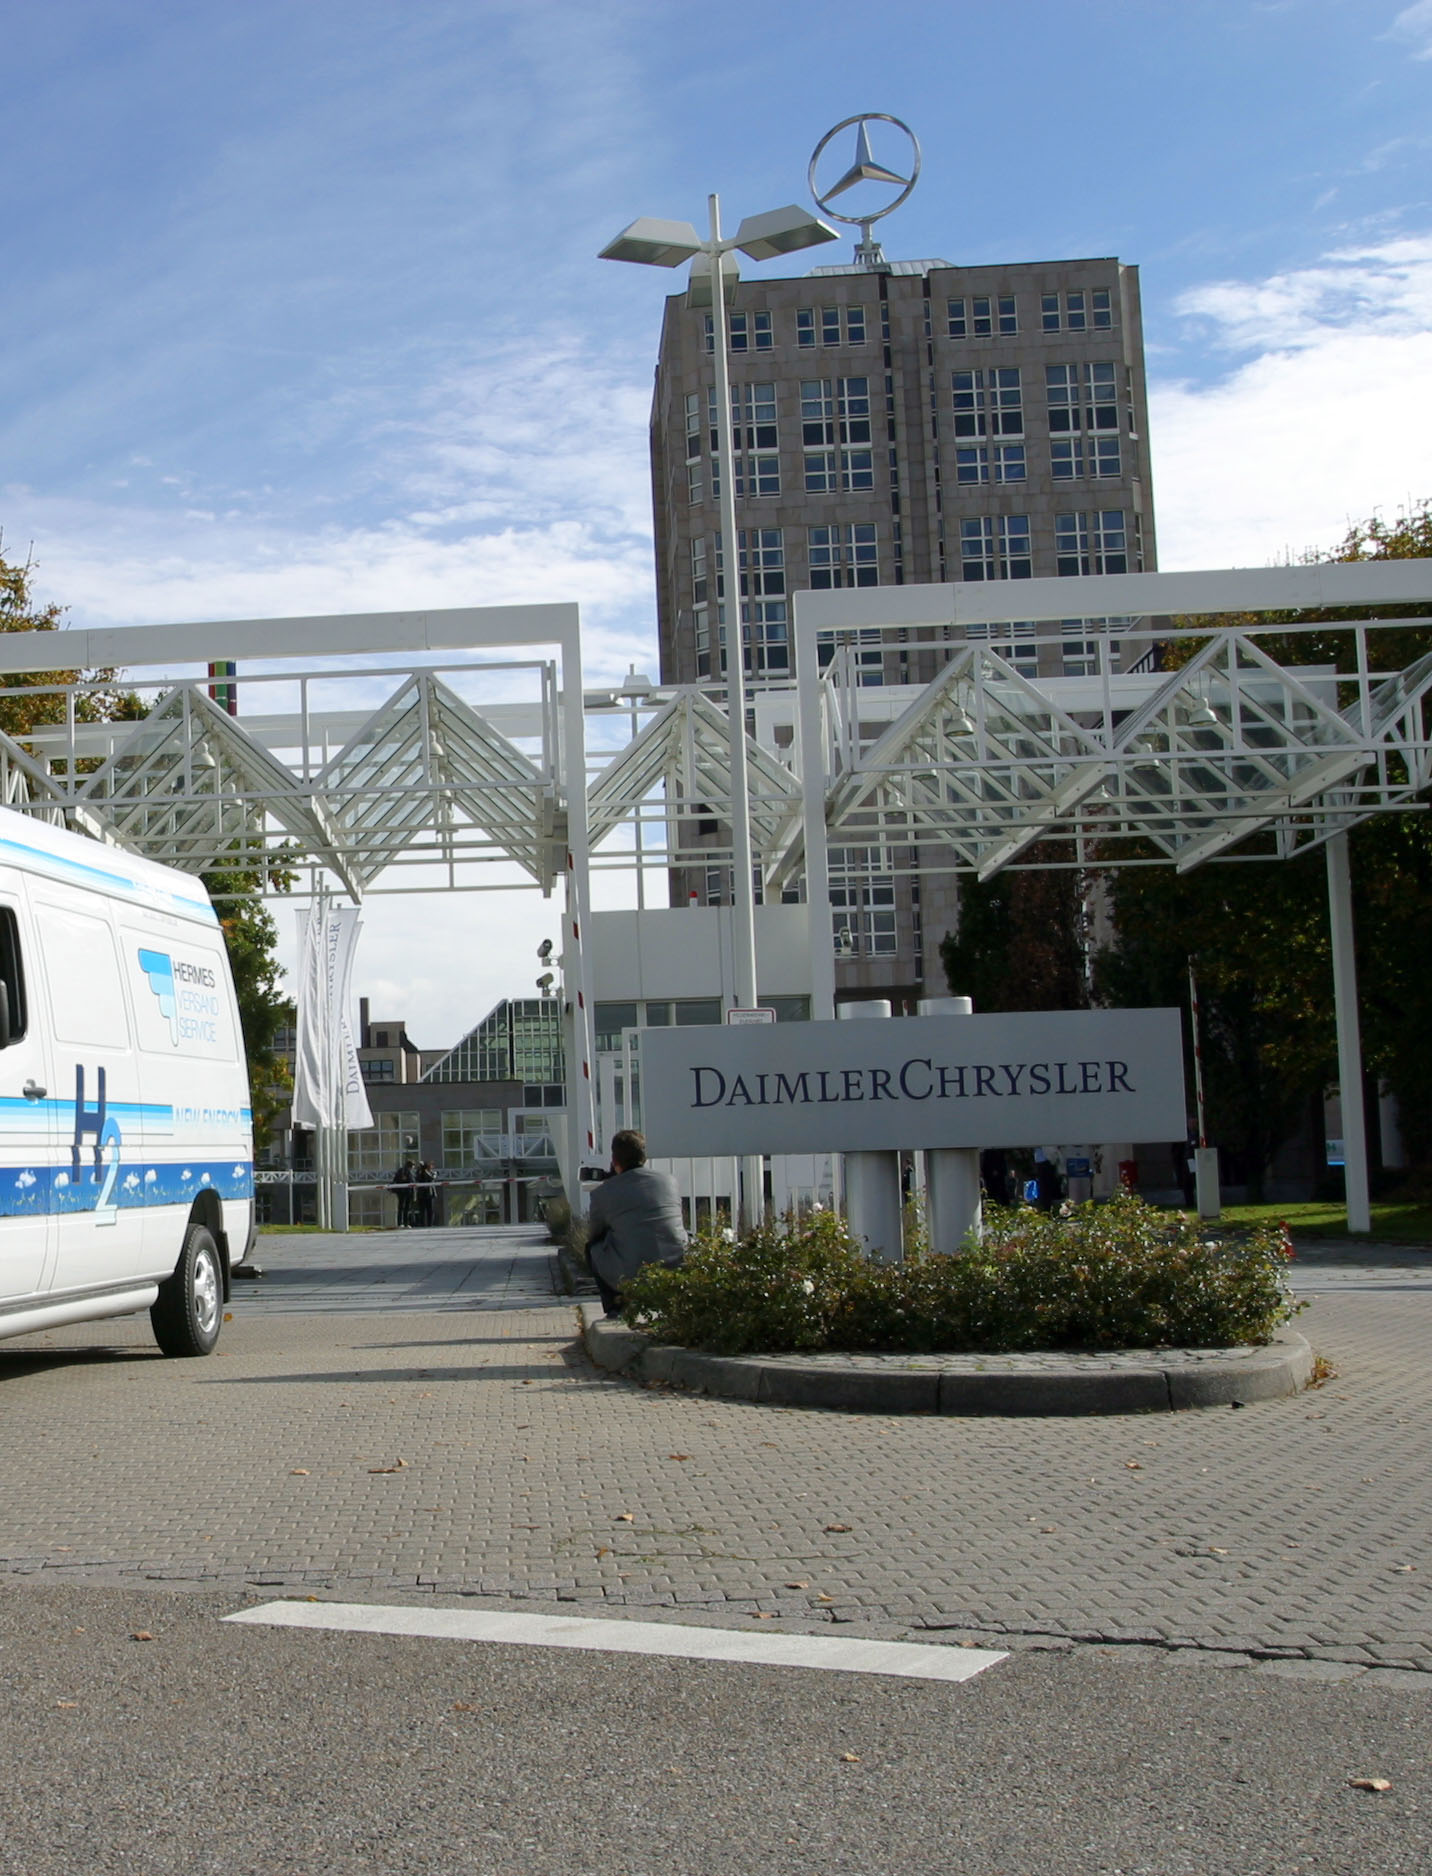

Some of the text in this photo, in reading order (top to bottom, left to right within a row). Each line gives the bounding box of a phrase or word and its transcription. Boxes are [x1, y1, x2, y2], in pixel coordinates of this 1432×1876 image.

[173, 960, 216, 988] HERMES
[176, 989, 220, 1016] VERSAND
[179, 1016, 217, 1042] SERVICE
